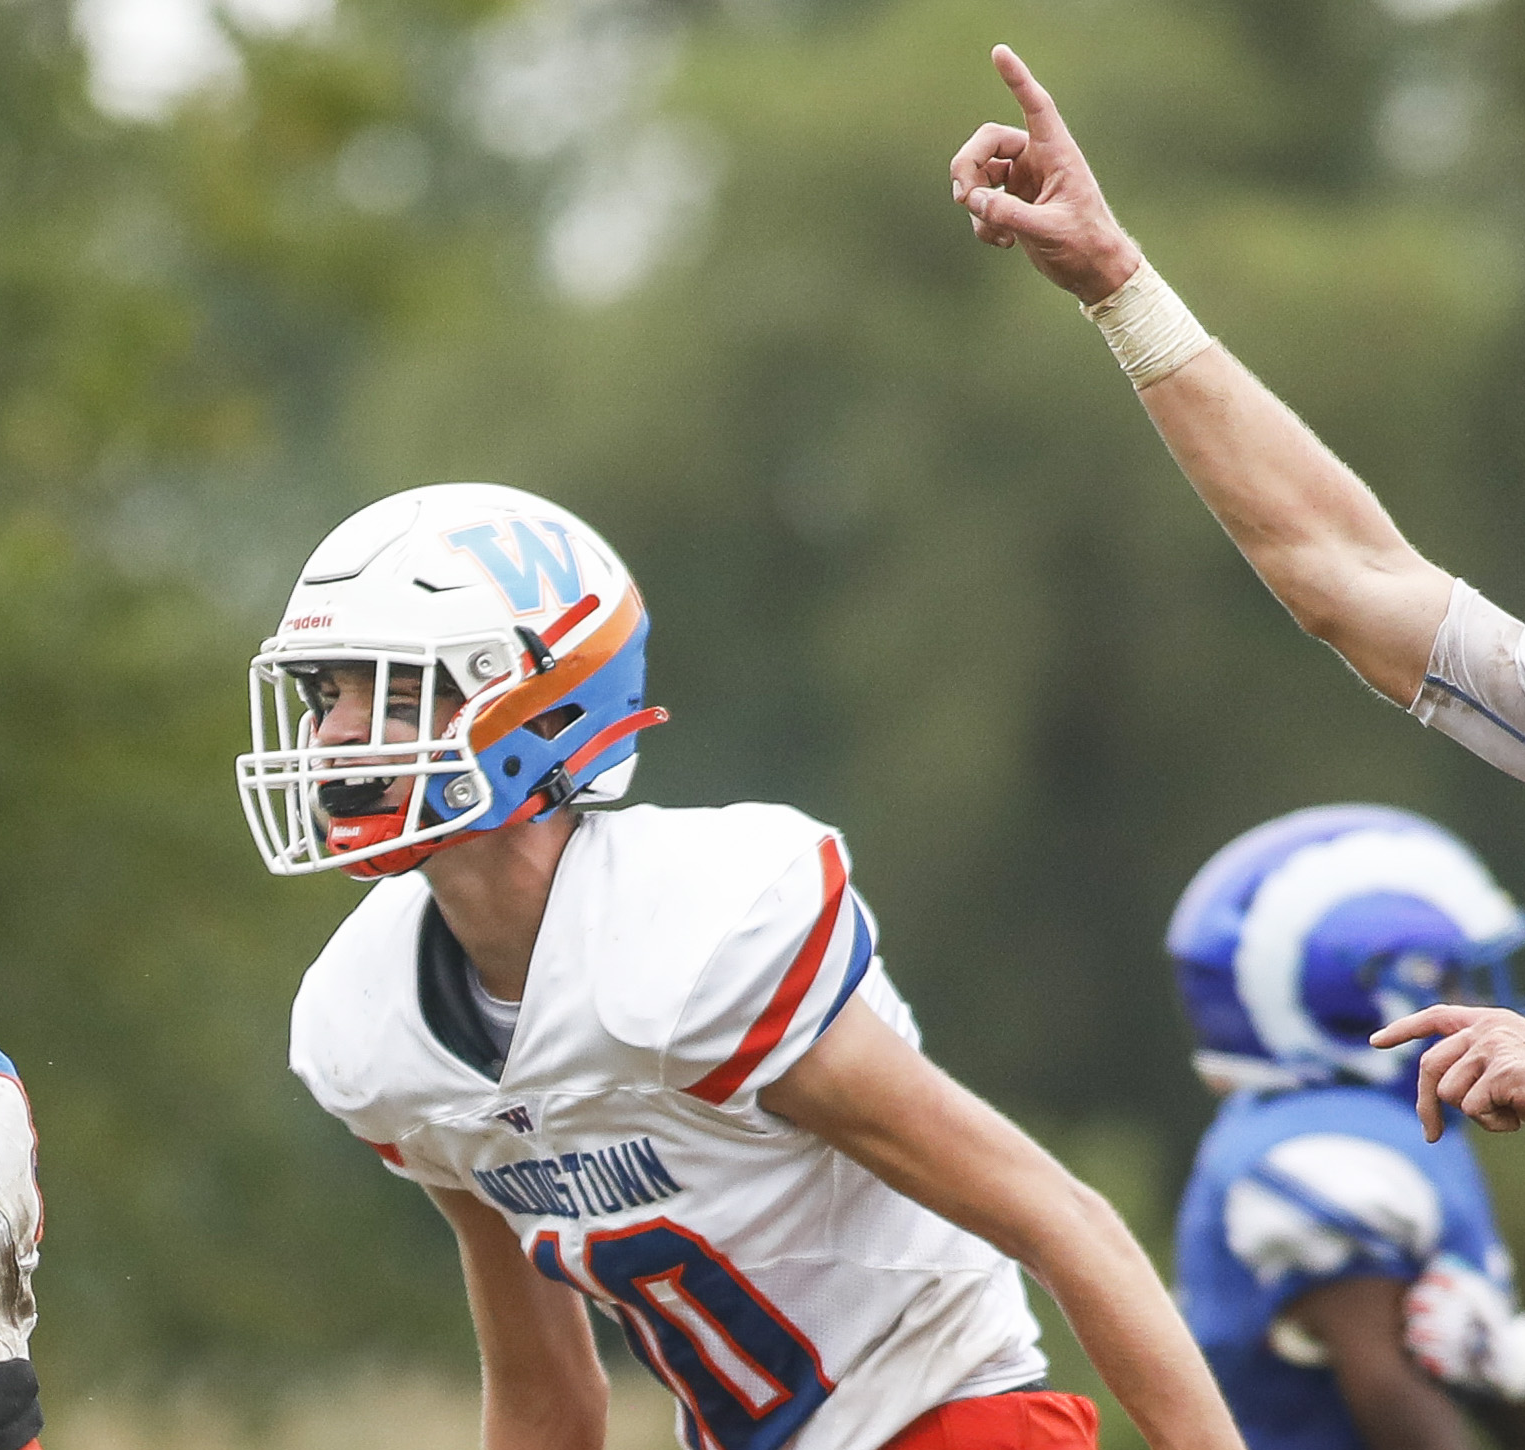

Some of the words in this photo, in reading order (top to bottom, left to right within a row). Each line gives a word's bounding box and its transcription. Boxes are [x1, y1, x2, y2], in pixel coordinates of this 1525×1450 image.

[438, 517, 588, 619] W
[495, 1104, 534, 1134] W
[471, 1136, 684, 1220] WOODSTOWN
